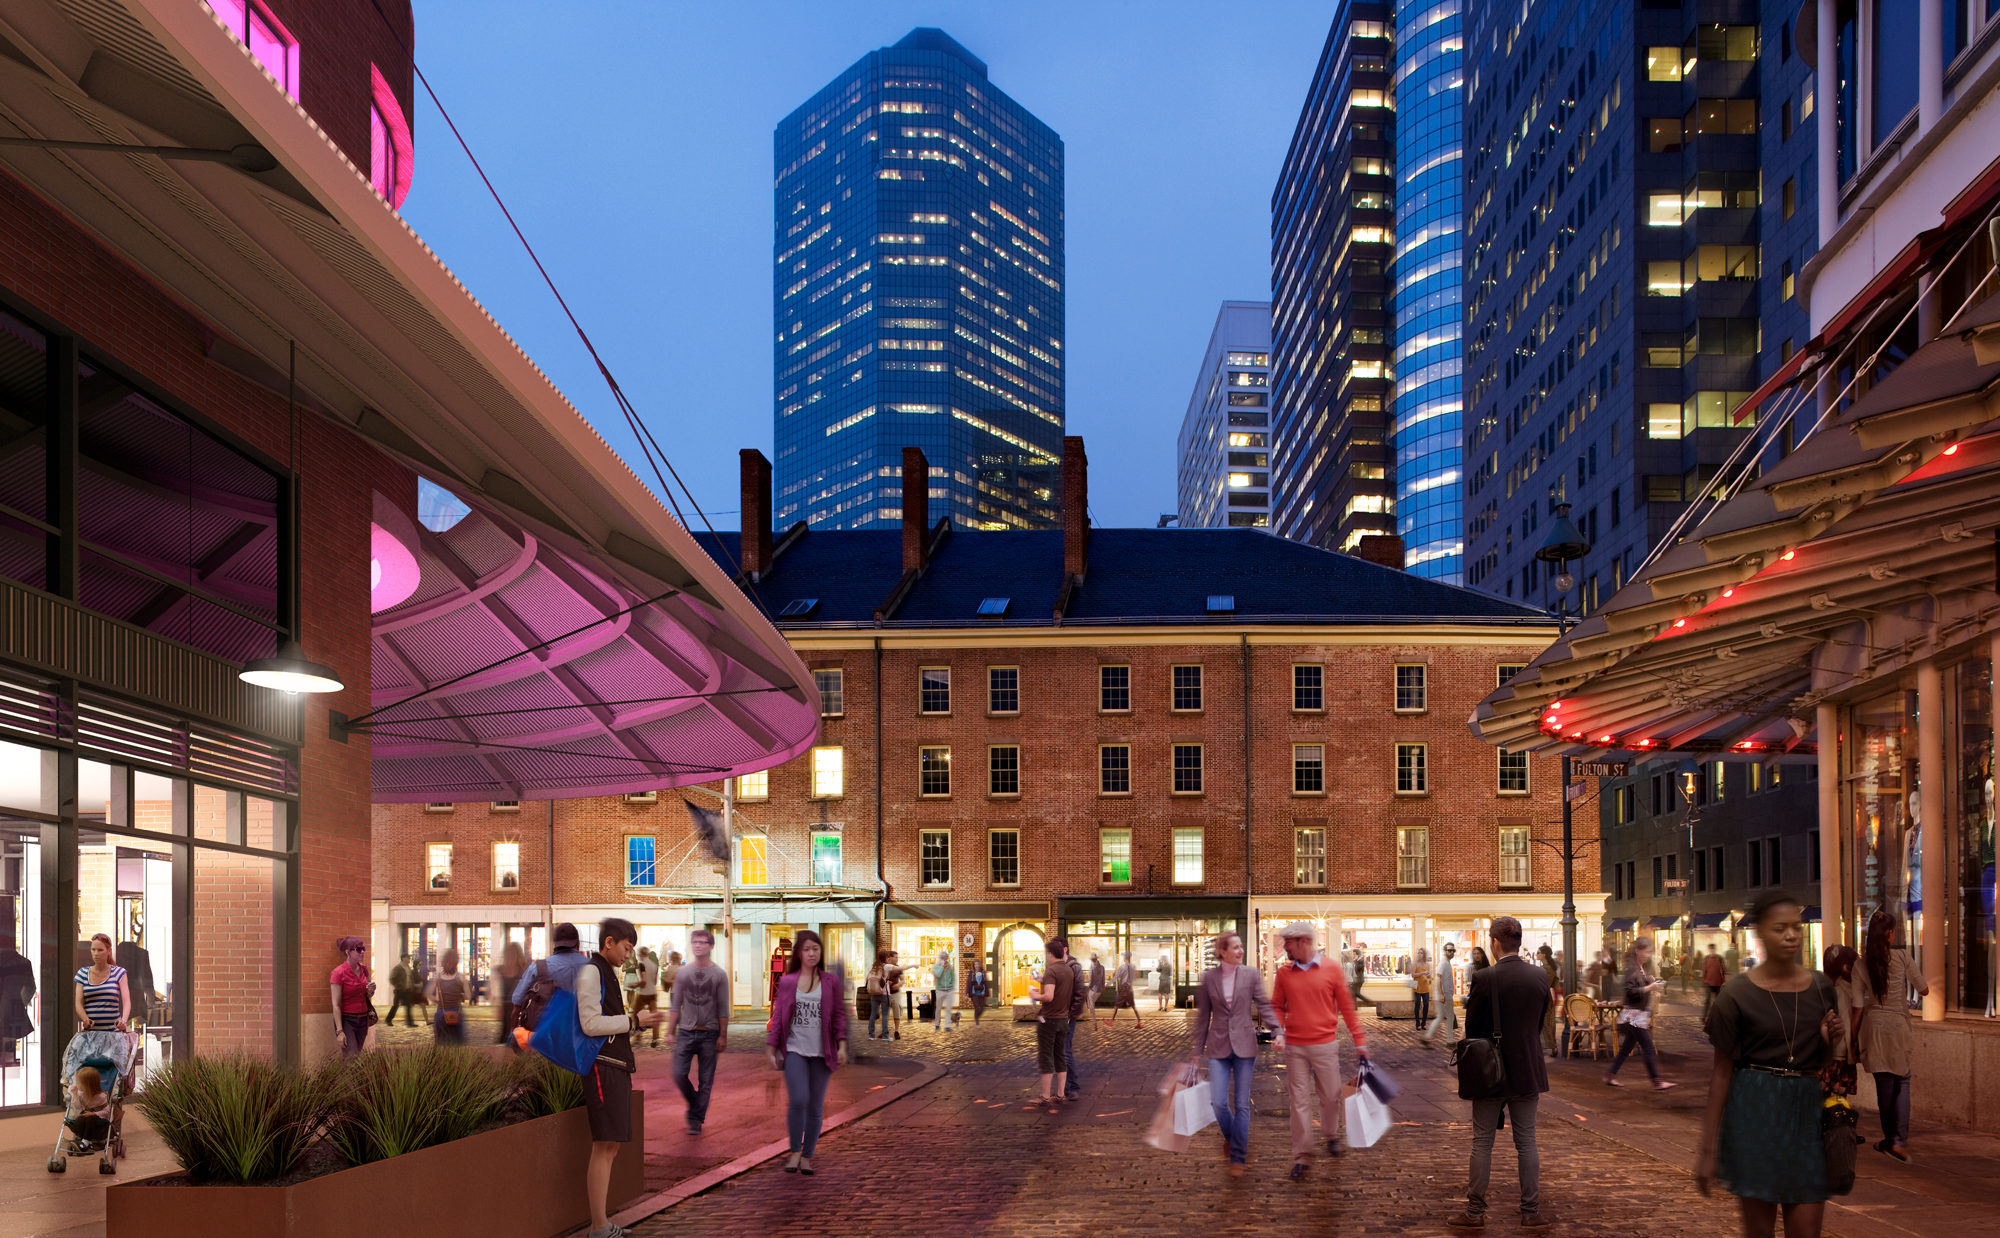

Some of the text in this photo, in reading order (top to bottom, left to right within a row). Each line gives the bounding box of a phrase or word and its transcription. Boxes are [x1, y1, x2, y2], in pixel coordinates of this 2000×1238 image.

[1577, 763, 1625, 776] FULTON ST
[795, 1009, 822, 1018] AINS
[793, 1017, 810, 1025] IDS
